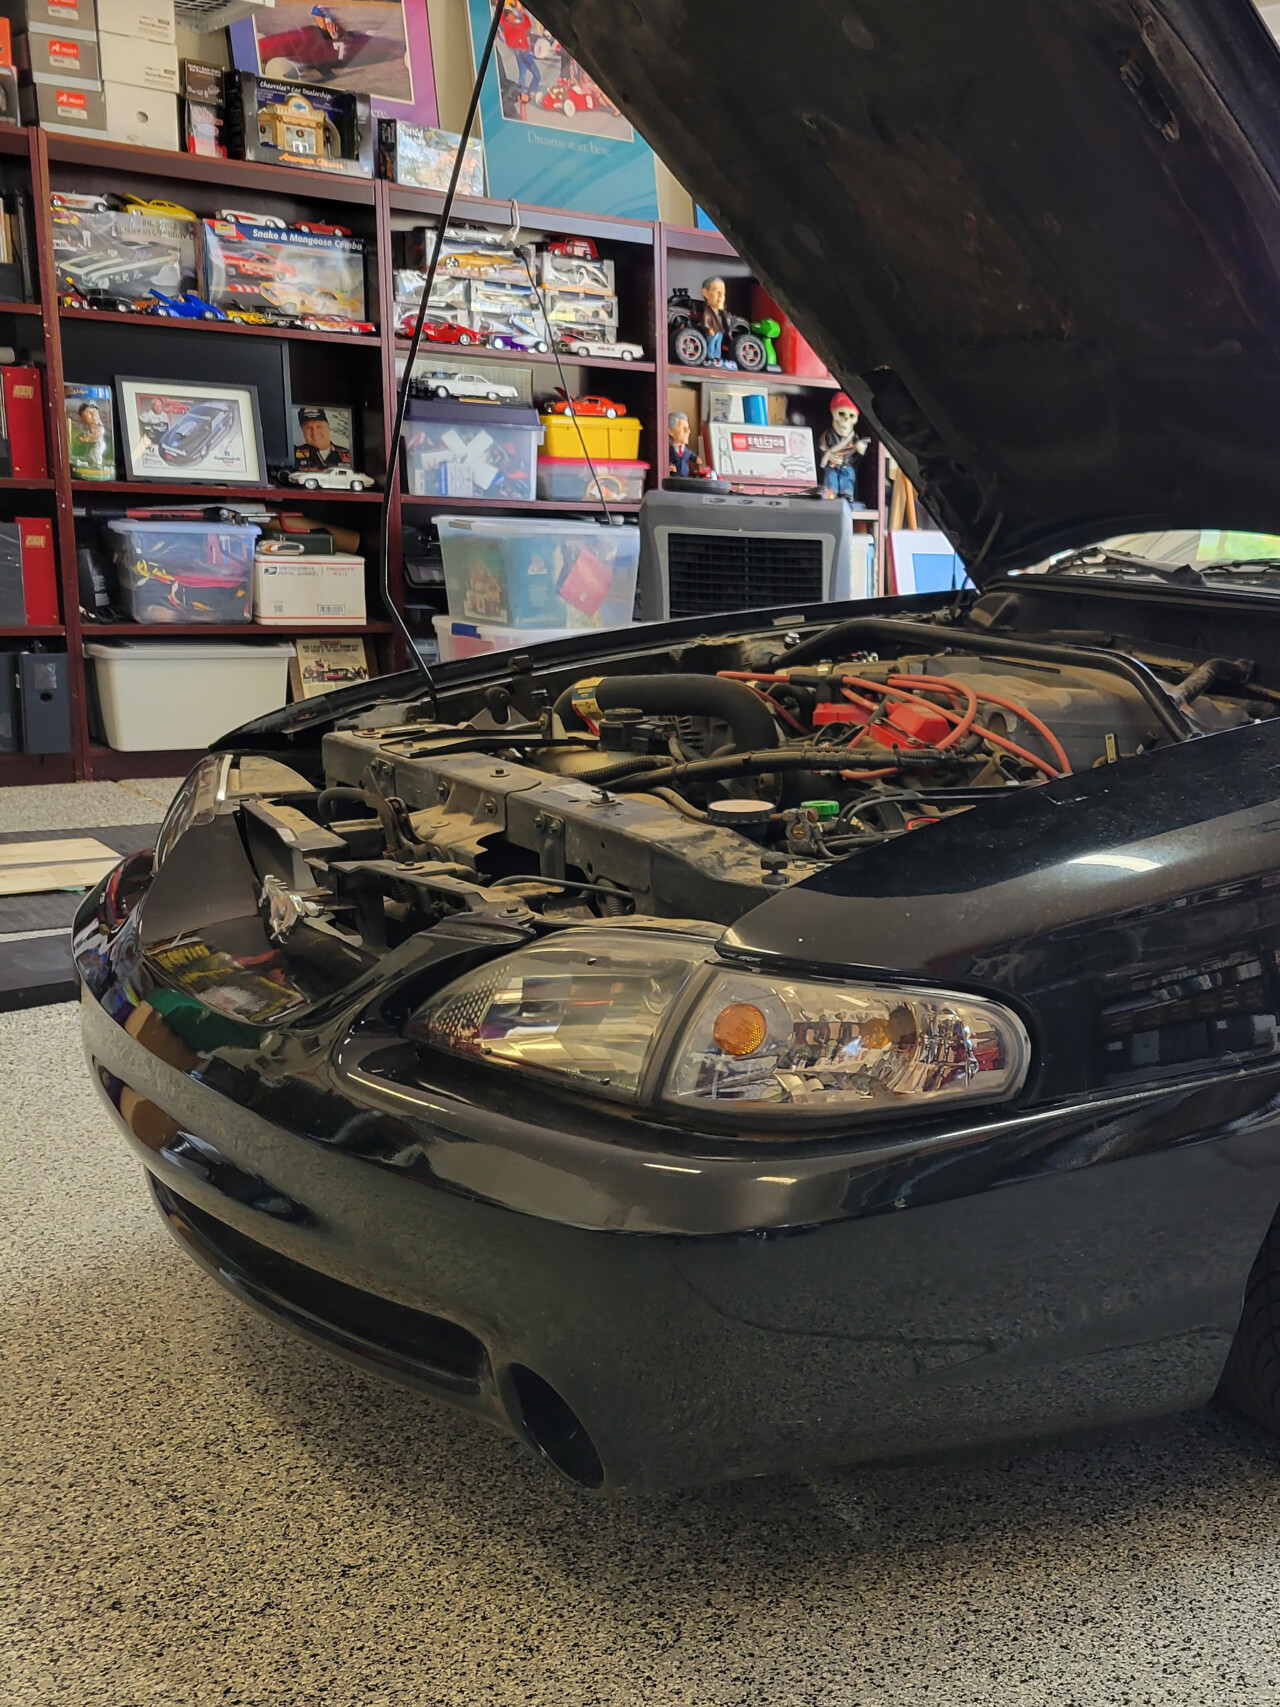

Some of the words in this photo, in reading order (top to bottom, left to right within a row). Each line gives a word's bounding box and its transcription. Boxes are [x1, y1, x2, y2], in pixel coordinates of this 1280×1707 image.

[332, 41, 345, 60] 7
[302, 87, 333, 102] Dealership
[370, 108, 390, 120] ere.
[526, 128, 566, 149] Dreams
[567, 140, 587, 154] start
[252, 227, 279, 241] Snake
[280, 231, 288, 241] &
[289, 233, 333, 248] Mongoose
[334, 239, 364, 252] Combo
[747, 435, 785, 449] ERECTOR
